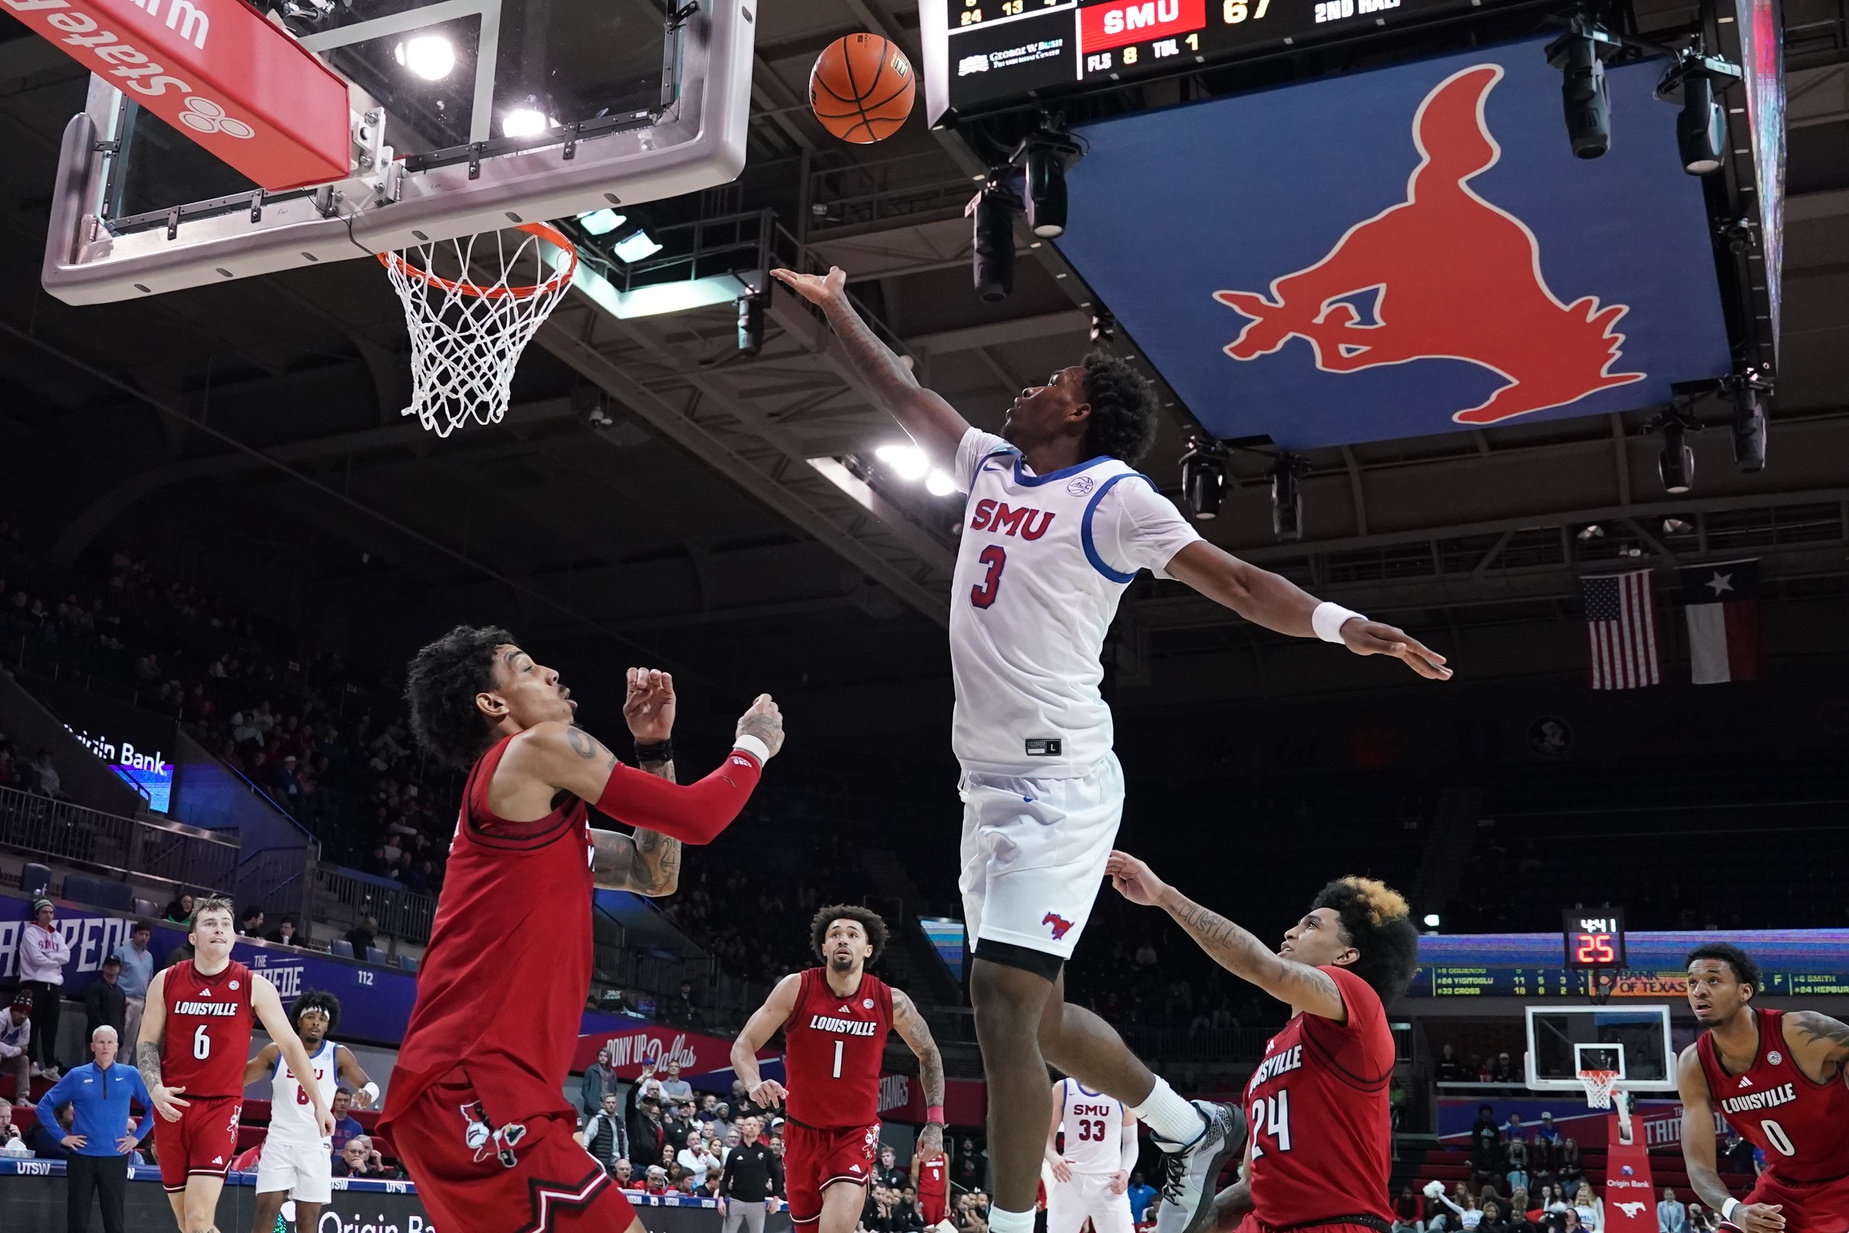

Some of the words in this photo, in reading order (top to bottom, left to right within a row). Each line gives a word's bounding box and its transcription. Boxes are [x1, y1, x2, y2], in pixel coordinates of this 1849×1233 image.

[961, 9, 982, 26] 24
[1104, 0, 1179, 34] SMU
[1315, 0, 1354, 23] 2ND
[46, 12, 193, 96] State
[1087, 53, 1112, 72] FLS
[1123, 47, 1138, 64] 8
[1153, 39, 1179, 58] TOL
[1186, 34, 1199, 51] 1
[970, 499, 1055, 541] SMU
[971, 545, 1007, 609] 3
[121, 743, 165, 776] Bank
[1581, 919, 1616, 933] 4:41
[1578, 935, 1614, 962] 25
[254, 955, 267, 967] THE
[358, 970, 373, 985] 112
[1513, 976, 1525, 985] 11
[1559, 976, 1567, 985] 3
[1620, 982, 1640, 993] OF
[1642, 982, 1686, 993] TEXAS
[1774, 974, 1782, 985] F
[1453, 987, 1480, 995] CROSS
[1560, 986, 1567, 995] 2
[174, 1001, 239, 1016] LOUISVILLE
[809, 1015, 877, 1036] LOUISVILLE
[193, 1025, 211, 1060] 6
[607, 1036, 632, 1067] PONY
[634, 1034, 647, 1063] UP
[647, 1034, 696, 1072] Dallas
[834, 1040, 844, 1078] 1
[286, 1069, 324, 1080] SU
[1721, 1083, 1796, 1114] LOUISVILLE
[1074, 1104, 1110, 1117] SMU
[1079, 1119, 1105, 1141] 33
[1252, 1090, 1291, 1161] 24
[1761, 1120, 1796, 1156] 0
[17, 1162, 50, 1175] UTSW
[933, 1169, 939, 1180] 9
[331, 1180, 348, 1190] TSW
[1607, 1180, 1630, 1188] Origin
